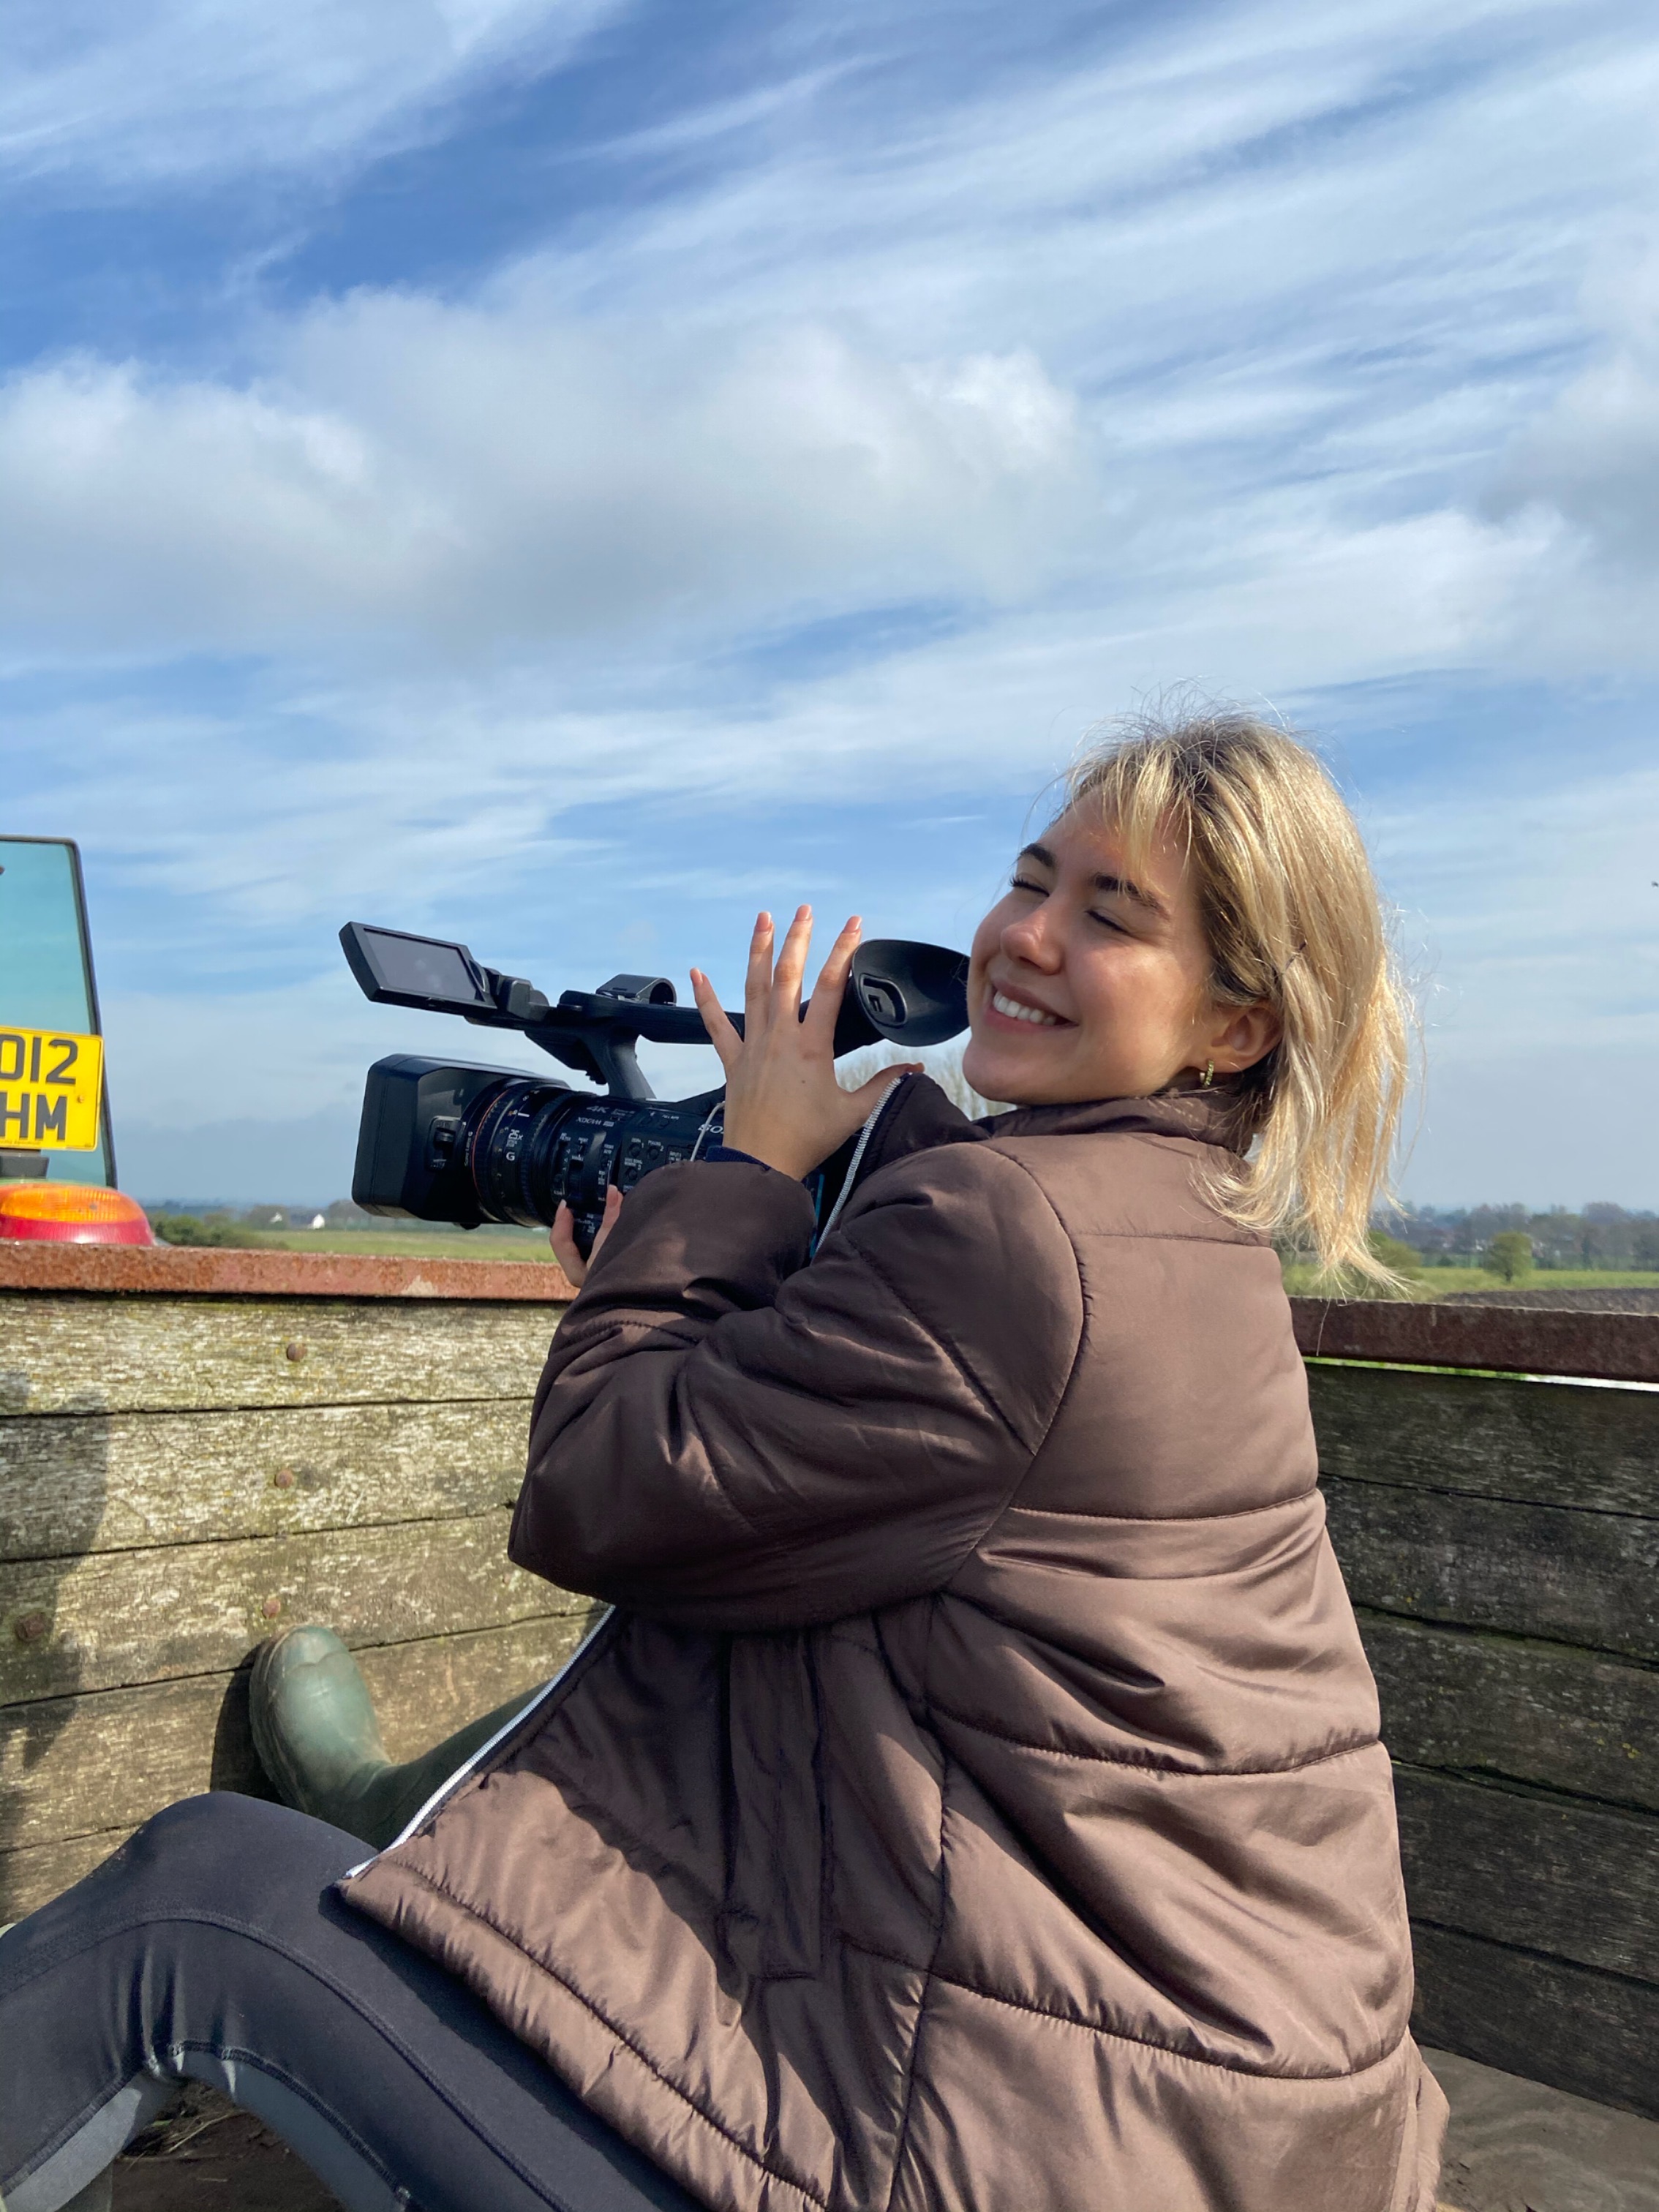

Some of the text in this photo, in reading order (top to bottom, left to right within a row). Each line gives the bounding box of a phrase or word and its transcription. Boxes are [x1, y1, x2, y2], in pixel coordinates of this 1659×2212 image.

[586, 1105, 610, 1114] 4K
[0, 1091, 68, 1142] HM
[508, 1129, 523, 1140] 25x
[698, 1124, 724, 1134] SO
[505, 1151, 516, 1162] G
